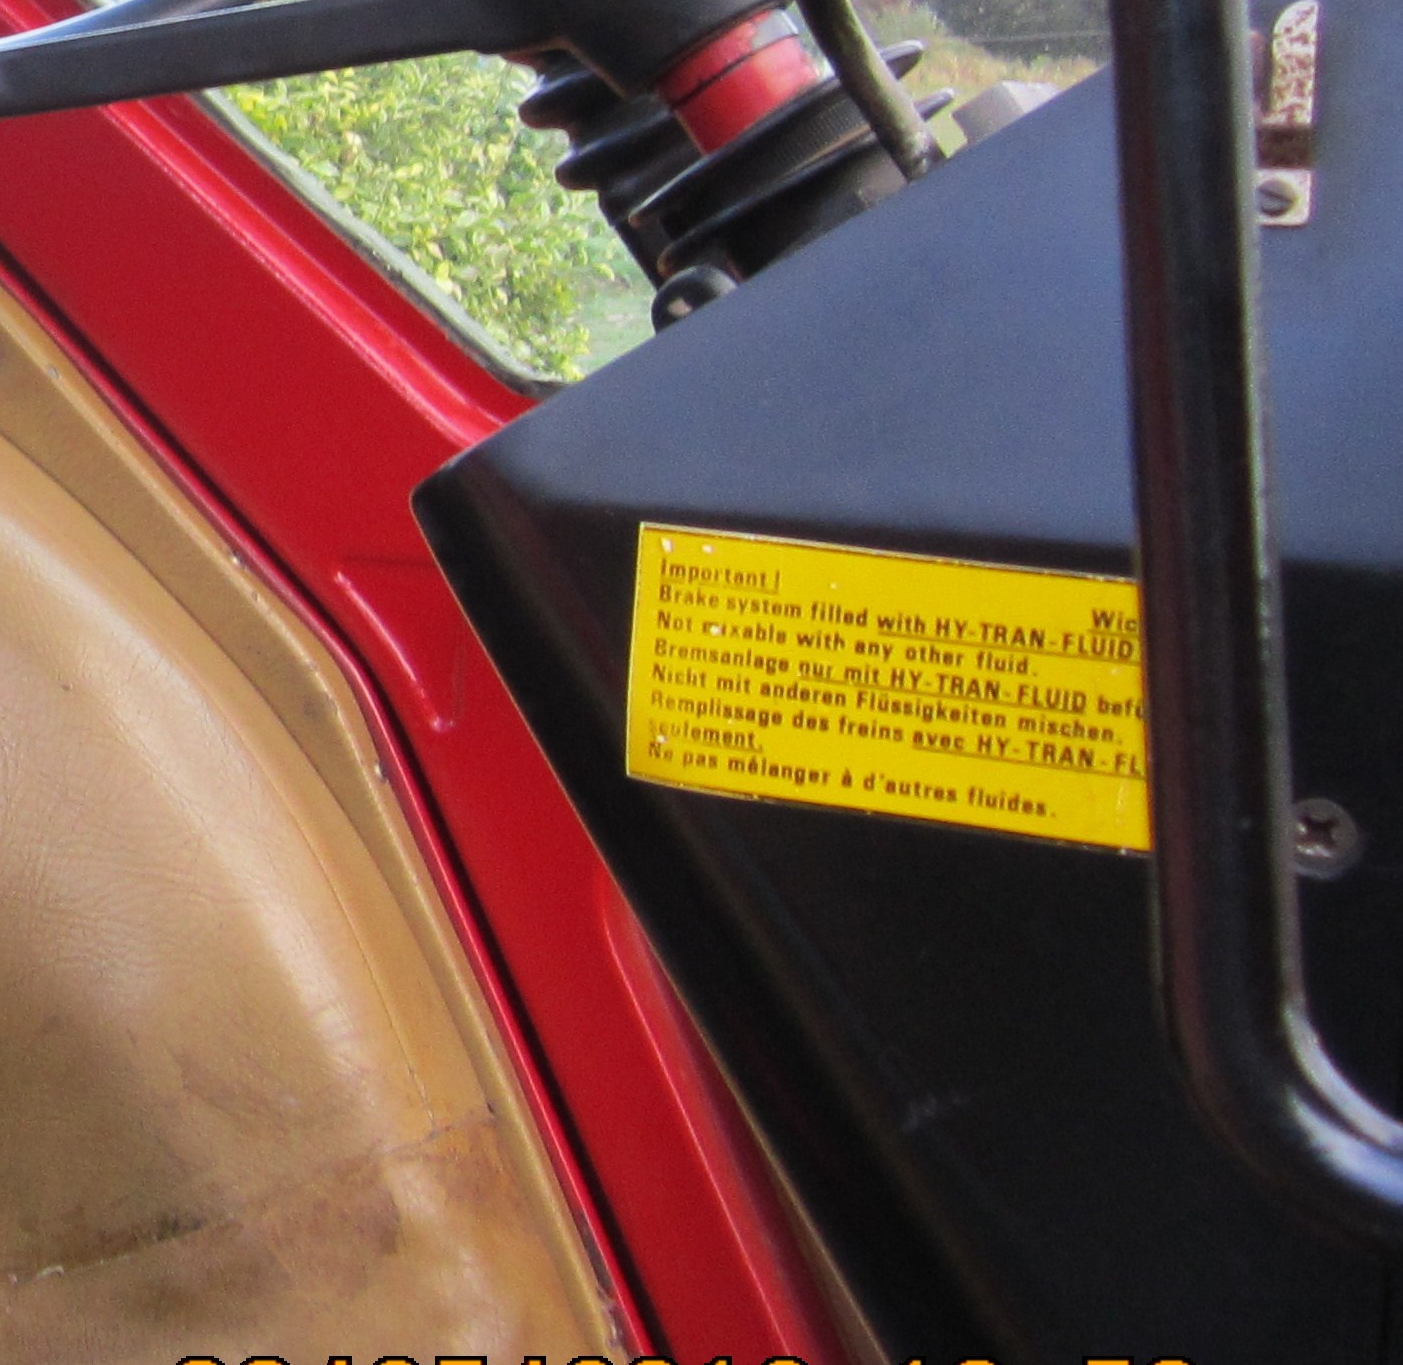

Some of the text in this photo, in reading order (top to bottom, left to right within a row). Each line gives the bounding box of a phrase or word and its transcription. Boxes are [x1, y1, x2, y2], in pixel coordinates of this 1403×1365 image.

[658, 584, 719, 608] Brake
[726, 595, 802, 618] system
[811, 601, 868, 627] filled
[877, 612, 926, 634] with
[654, 637, 789, 675] Bremsanlage
[799, 660, 833, 679] nur
[844, 663, 879, 685] mit
[657, 609, 692, 633] Not
[796, 631, 846, 650] with
[854, 640, 894, 662] any
[905, 645, 964, 667] other
[650, 689, 783, 728] Remplissage
[792, 710, 830, 732] des
[839, 715, 904, 742] freins
[912, 730, 965, 749] avec
[651, 662, 707, 688] Nicht
[716, 674, 751, 694] mit
[760, 681, 846, 706] anderen
[856, 690, 1007, 727] Flüssigkeiten
[648, 741, 673, 761] Ne
[682, 750, 718, 768] pas
[841, 767, 853, 787] à
